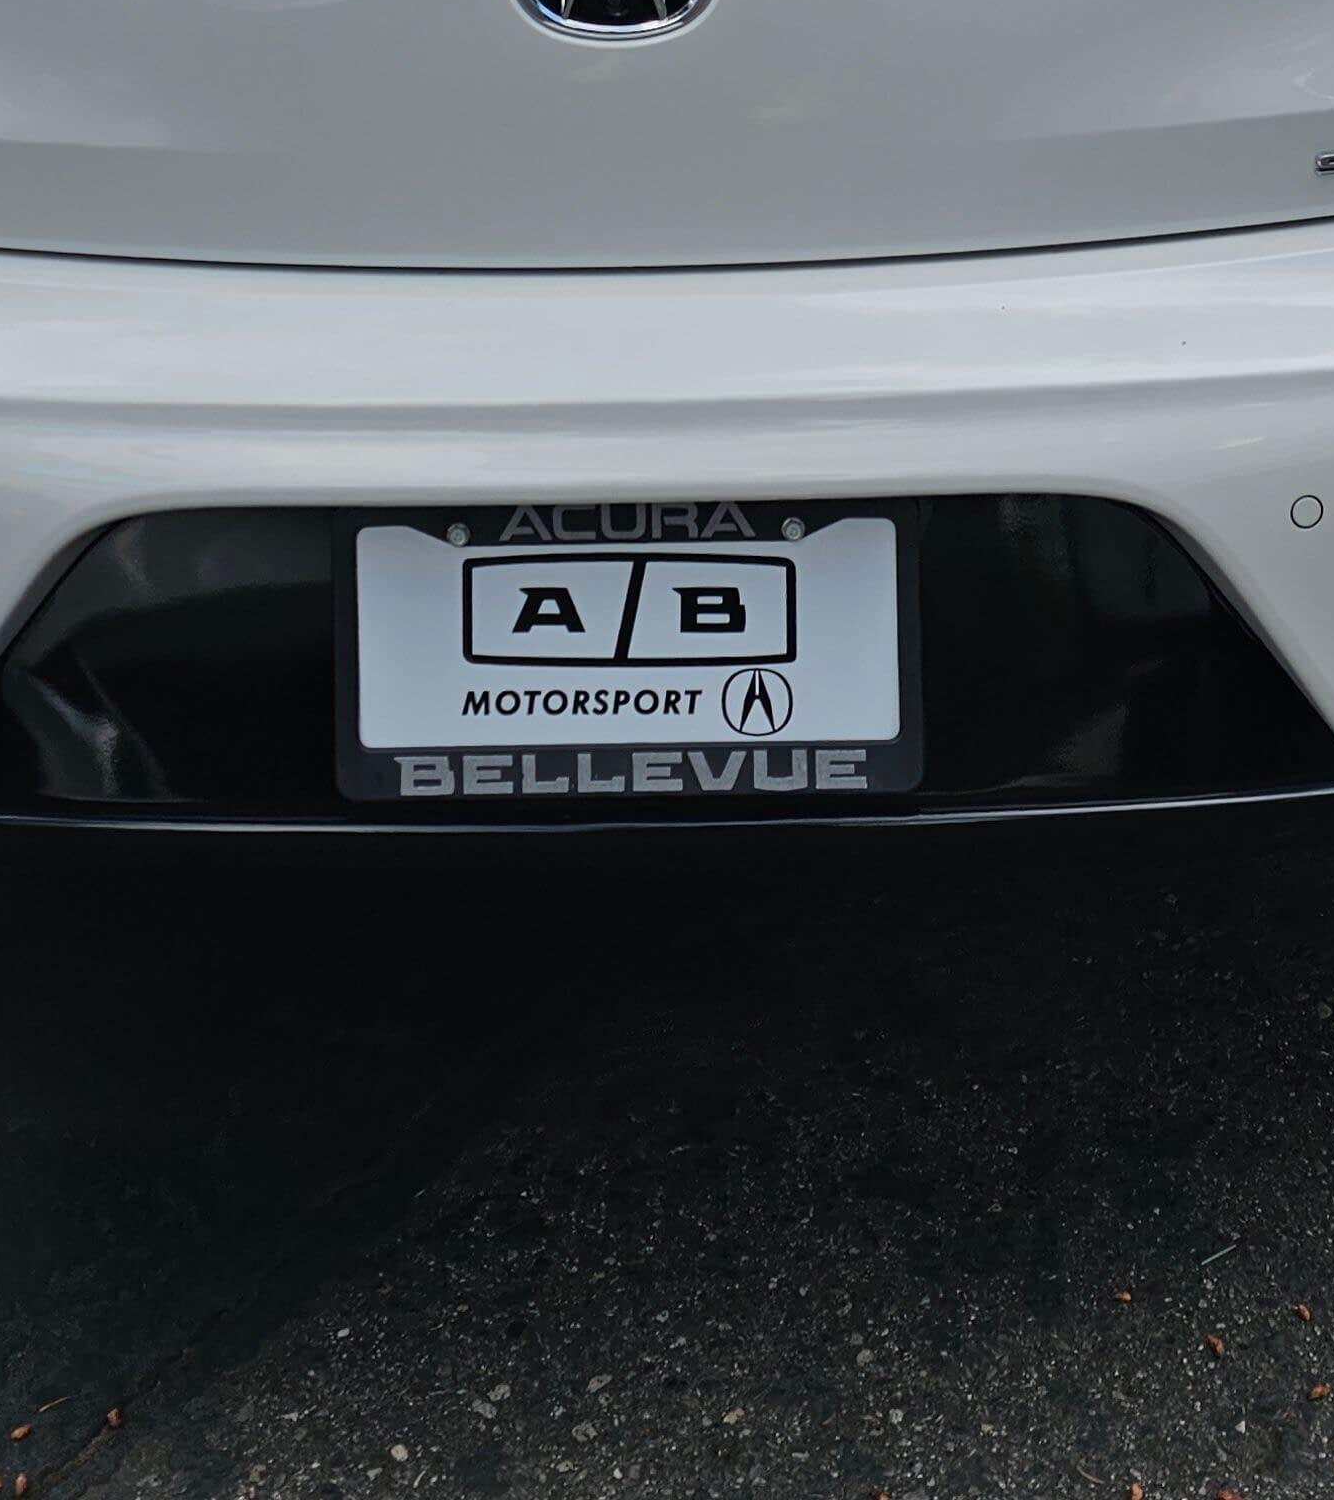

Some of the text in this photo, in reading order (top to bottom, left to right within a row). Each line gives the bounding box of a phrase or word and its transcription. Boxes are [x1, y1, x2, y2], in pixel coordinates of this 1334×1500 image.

[498, 502, 757, 543] ACURA
[511, 586, 746, 634] A B
[461, 689, 704, 718] MOTORSPORT
[394, 750, 867, 796] BELLEVUE
